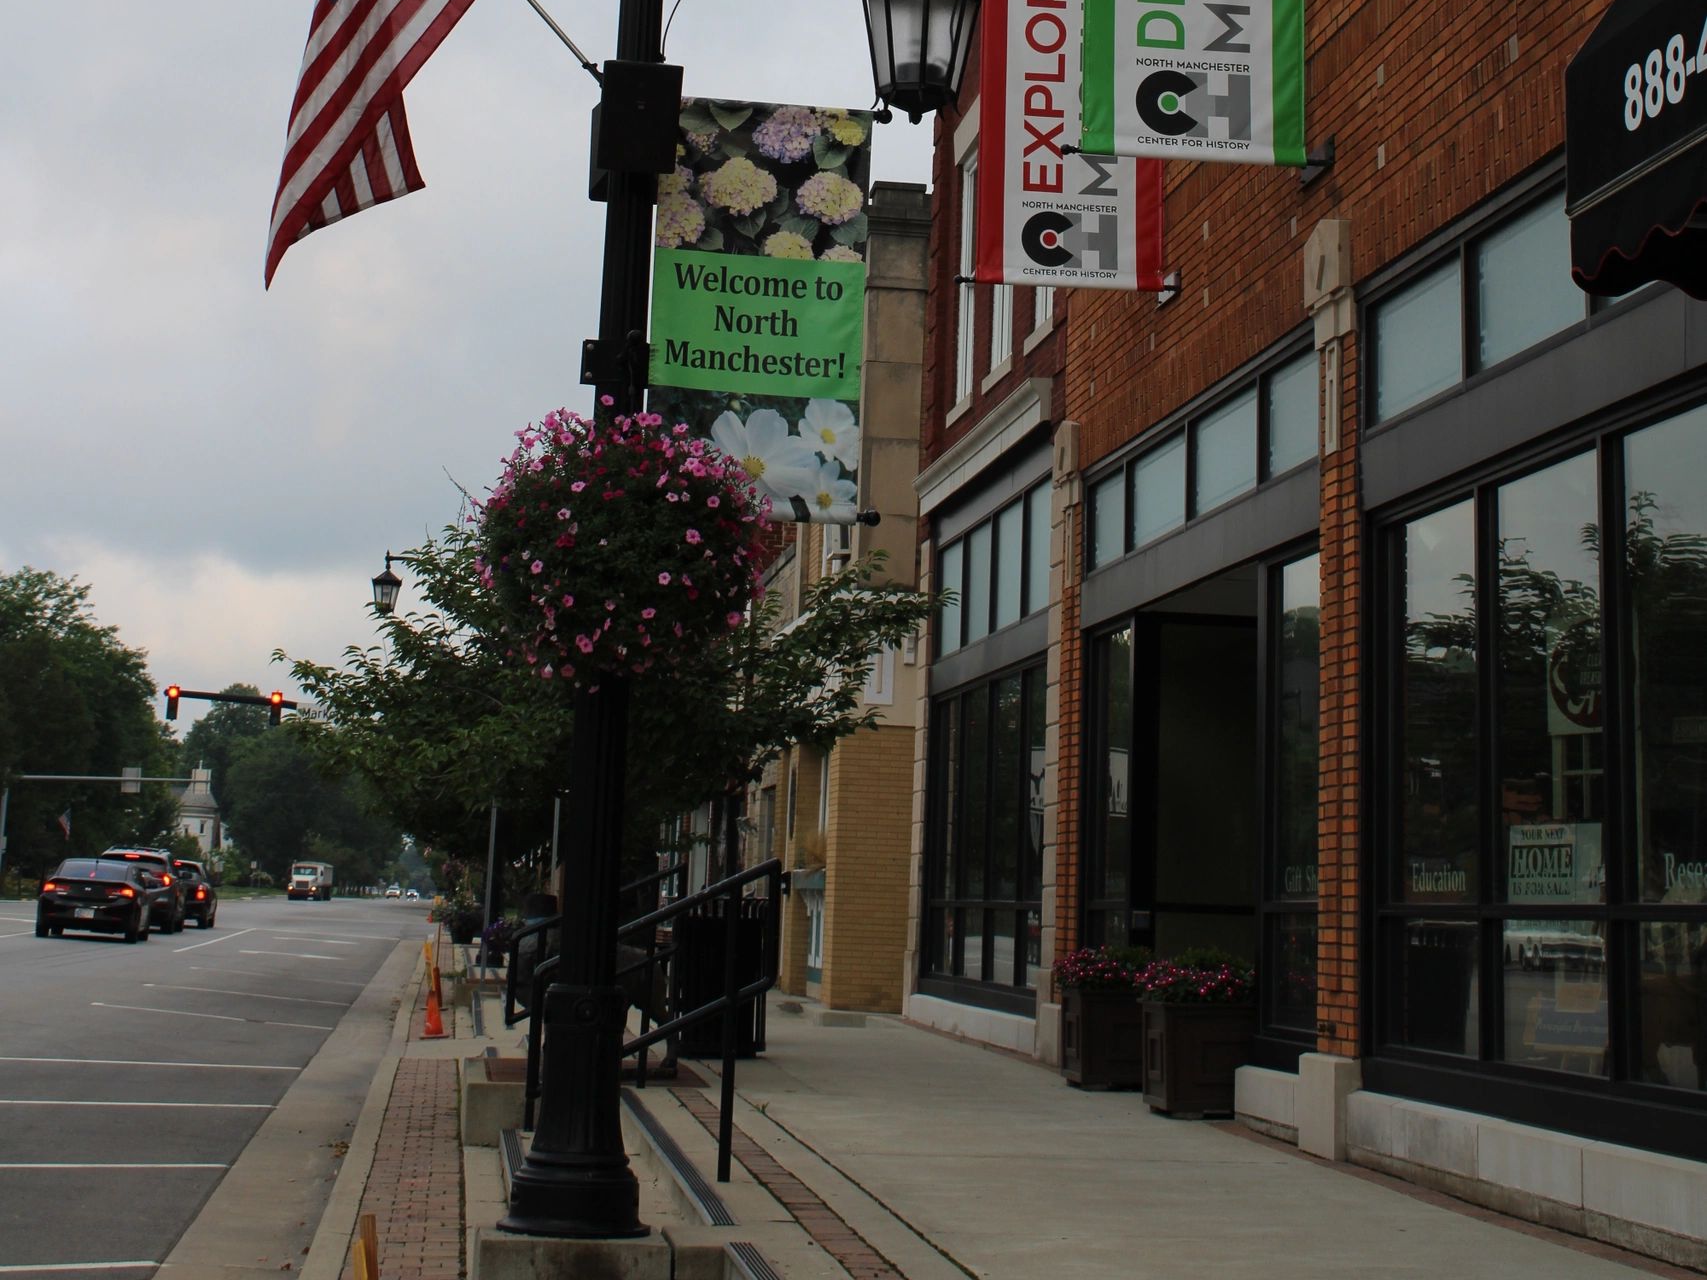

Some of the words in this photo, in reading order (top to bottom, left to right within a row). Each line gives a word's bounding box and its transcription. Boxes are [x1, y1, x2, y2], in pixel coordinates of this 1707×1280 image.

[1136, 58, 1173, 68] NORTH
[1176, 61, 1250, 73] MANCHESTER
[1137, 136, 1178, 146] CENTER
[1182, 139, 1203, 148] FOR
[1206, 140, 1250, 150] HISTORY
[1022, 201, 1053, 209] NORTH
[1056, 203, 1117, 213] MANCHESTER
[674, 262, 808, 299] Welcome
[814, 276, 843, 301] to
[1022, 268, 1057, 276] CENTER
[1080, 271, 1117, 279] HISTORY
[713, 304, 799, 337] North
[664, 338, 846, 379] Manchester!
[1520, 828, 1542, 840] YOUR
[1544, 827, 1565, 840] NEXT
[1513, 846, 1571, 875] HOME
[1284, 865, 1302, 893] Gift
[1412, 862, 1466, 892] Education
[1512, 881, 1522, 896] IS
[1524, 881, 1544, 895] FOR
